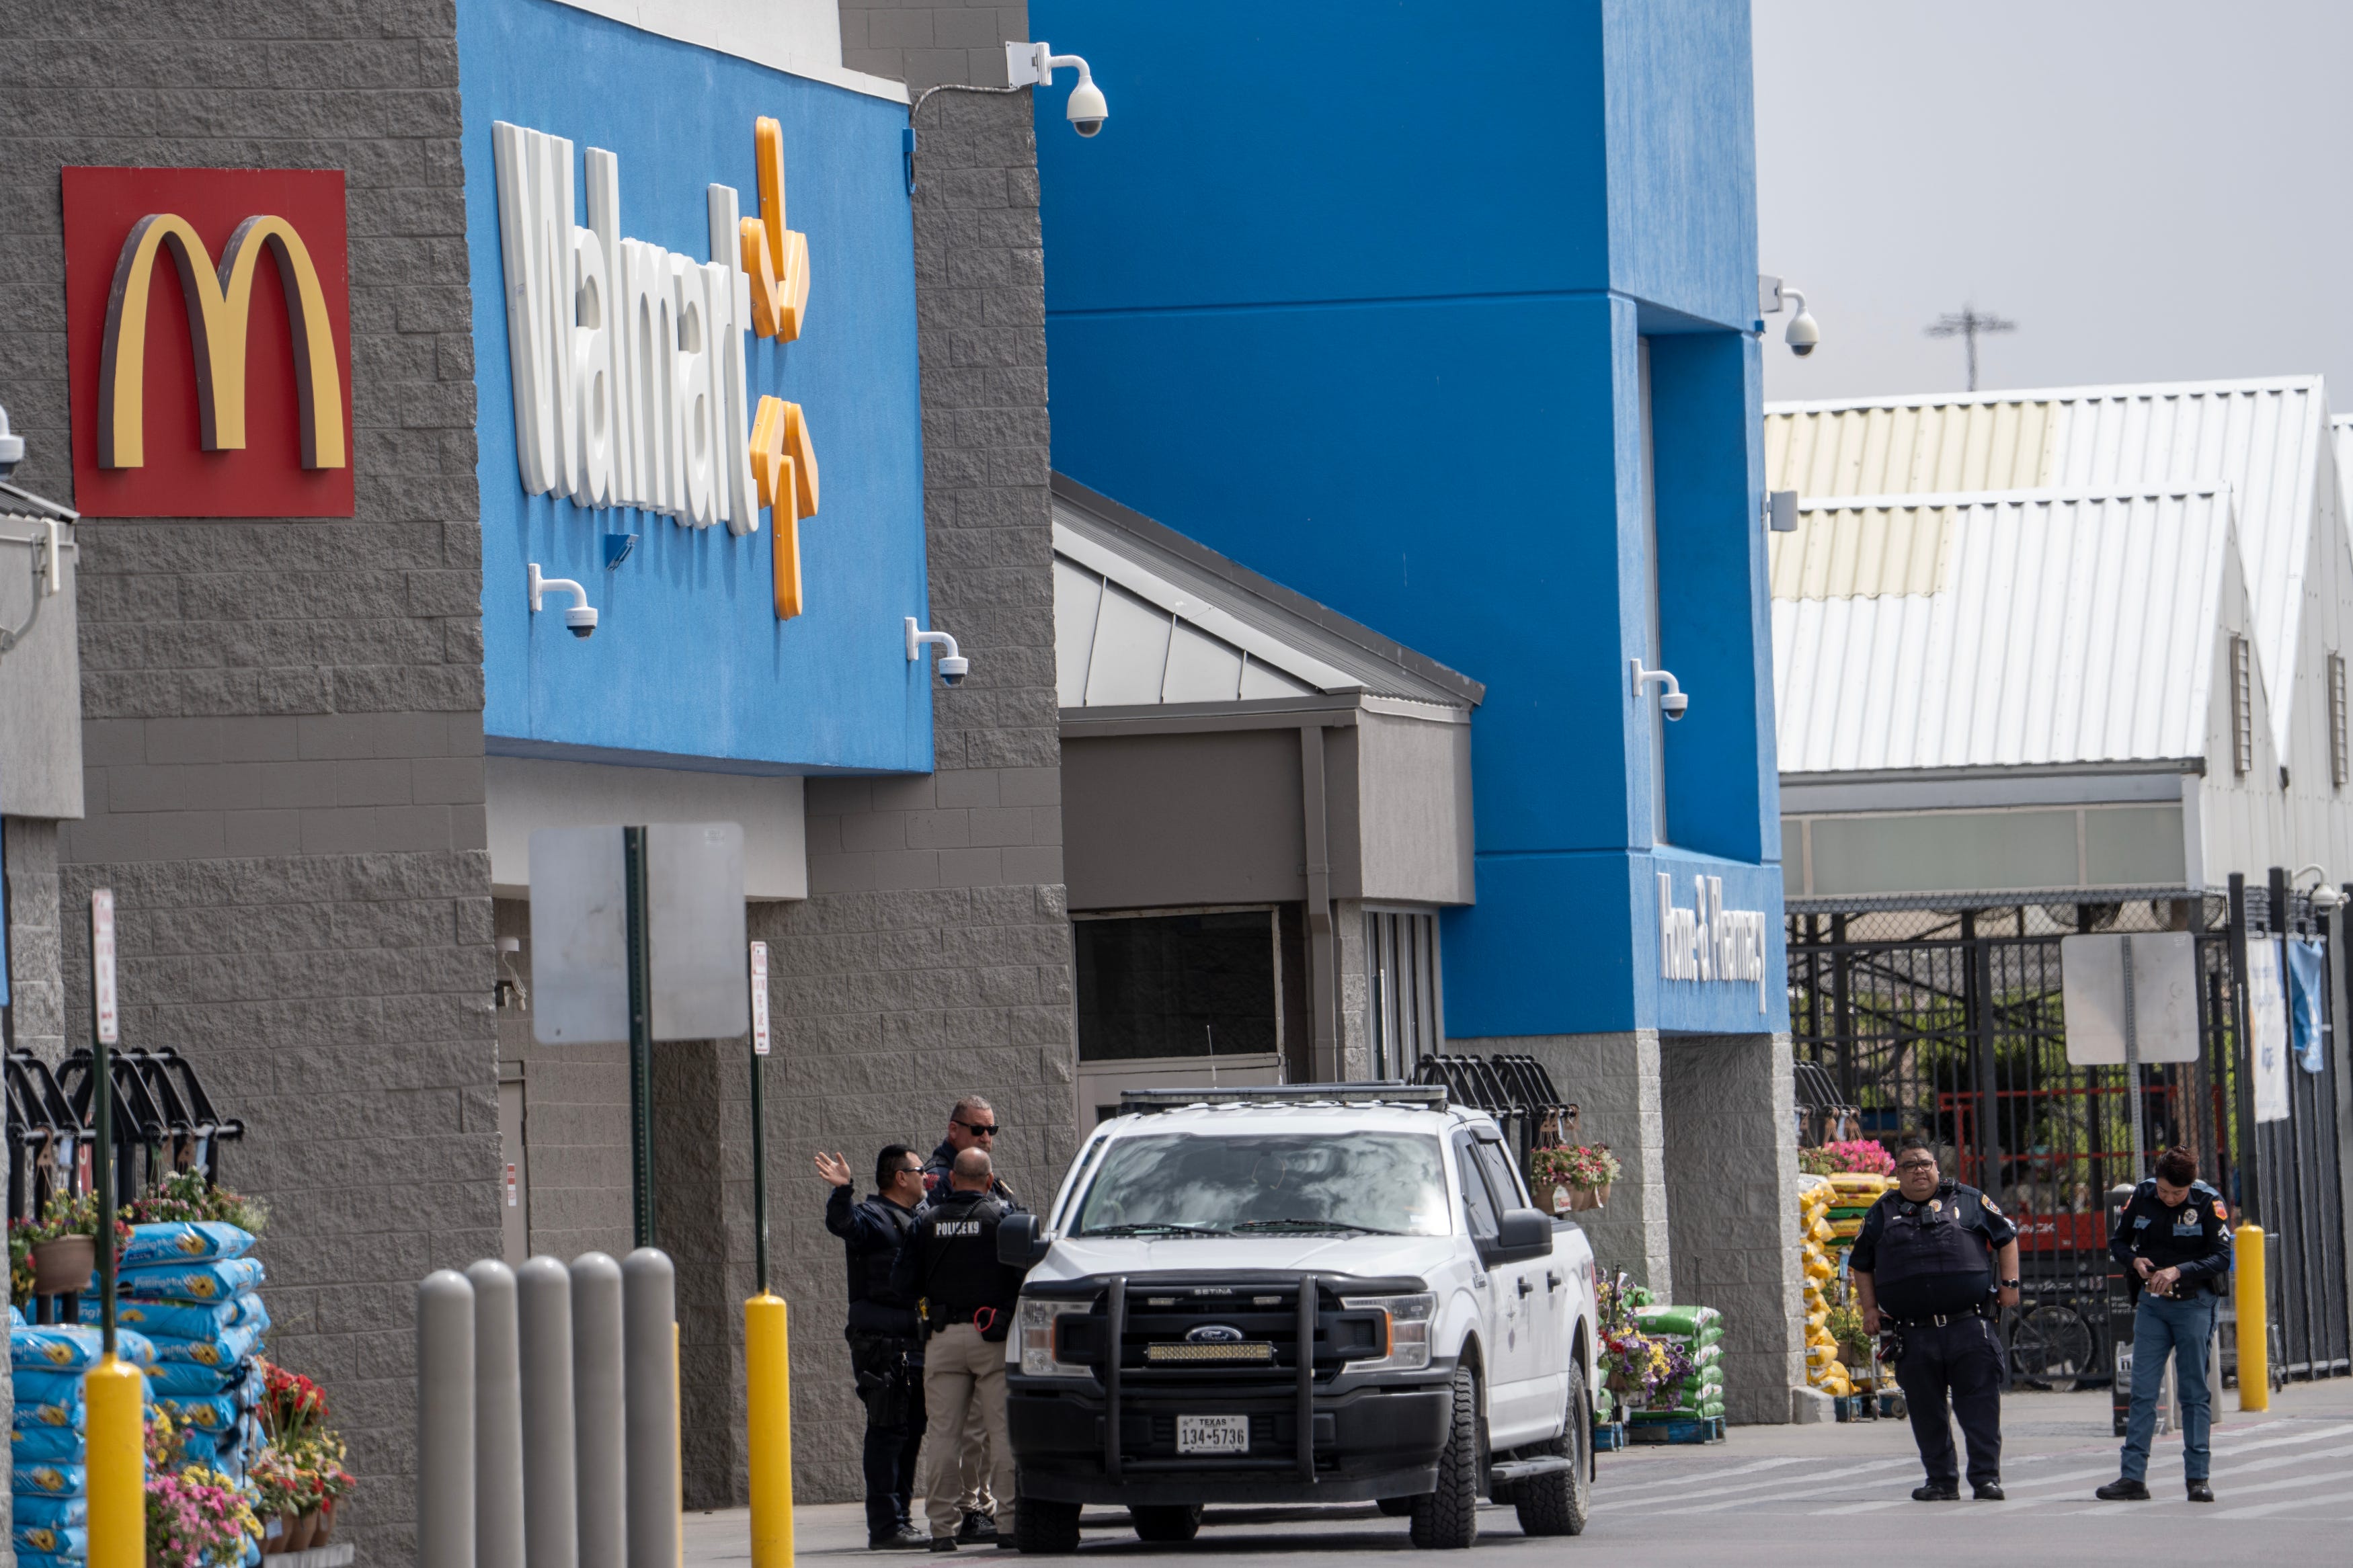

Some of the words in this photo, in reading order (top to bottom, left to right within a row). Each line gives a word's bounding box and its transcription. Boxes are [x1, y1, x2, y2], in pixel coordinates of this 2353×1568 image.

[493, 120, 758, 536] Walmart
[1657, 872, 1698, 981] Home
[1706, 876, 1766, 1014] Pharmacy
[935, 1221, 967, 1236] POLICE
[967, 1220, 980, 1235] K9
